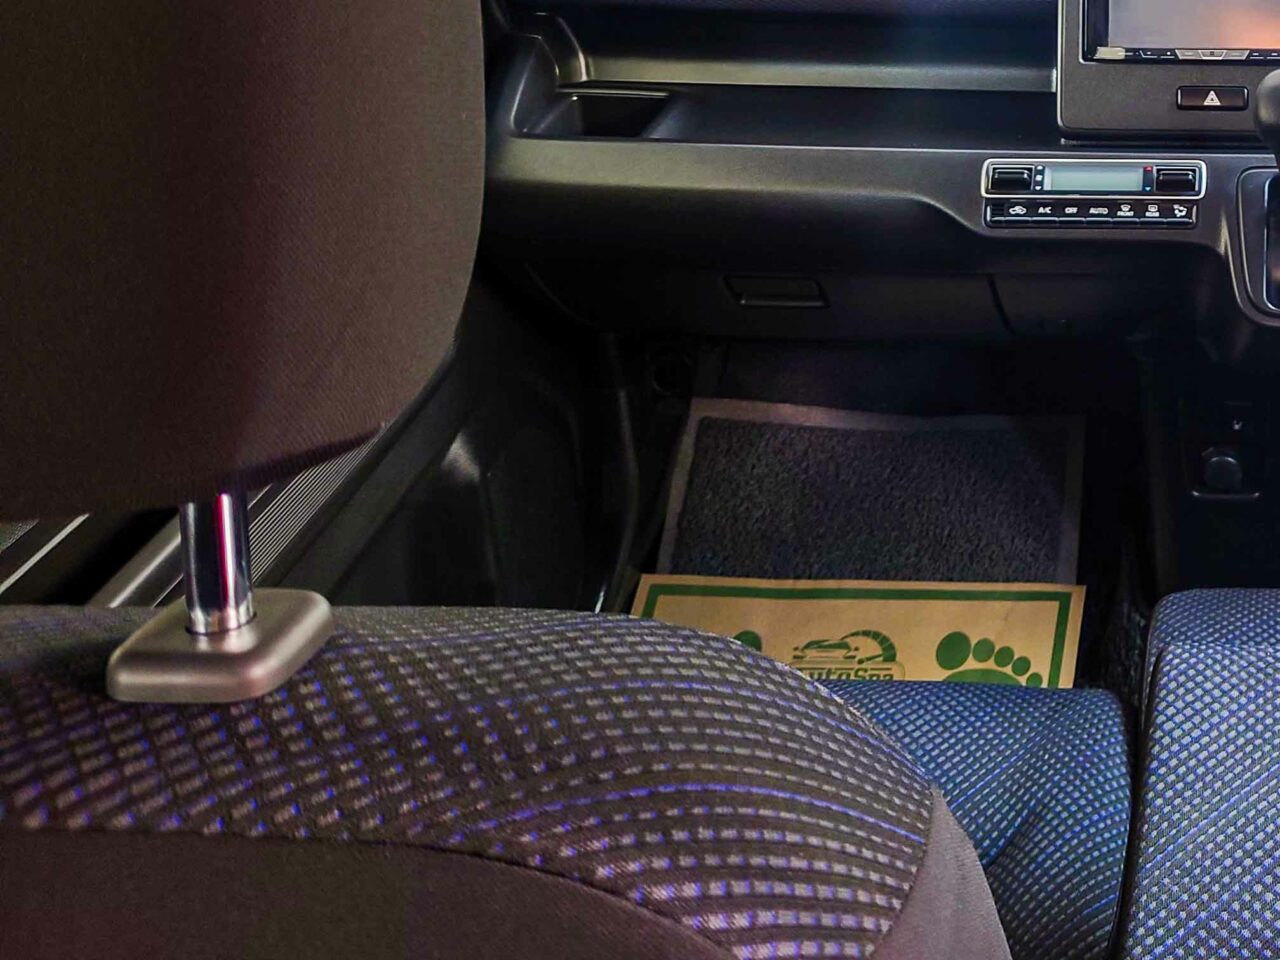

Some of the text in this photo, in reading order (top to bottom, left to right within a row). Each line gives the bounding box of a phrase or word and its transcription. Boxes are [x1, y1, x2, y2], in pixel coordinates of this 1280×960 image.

[1037, 206, 1052, 214] A/C
[1064, 206, 1078, 214] OFF
[1088, 207, 1109, 215] AUTO
